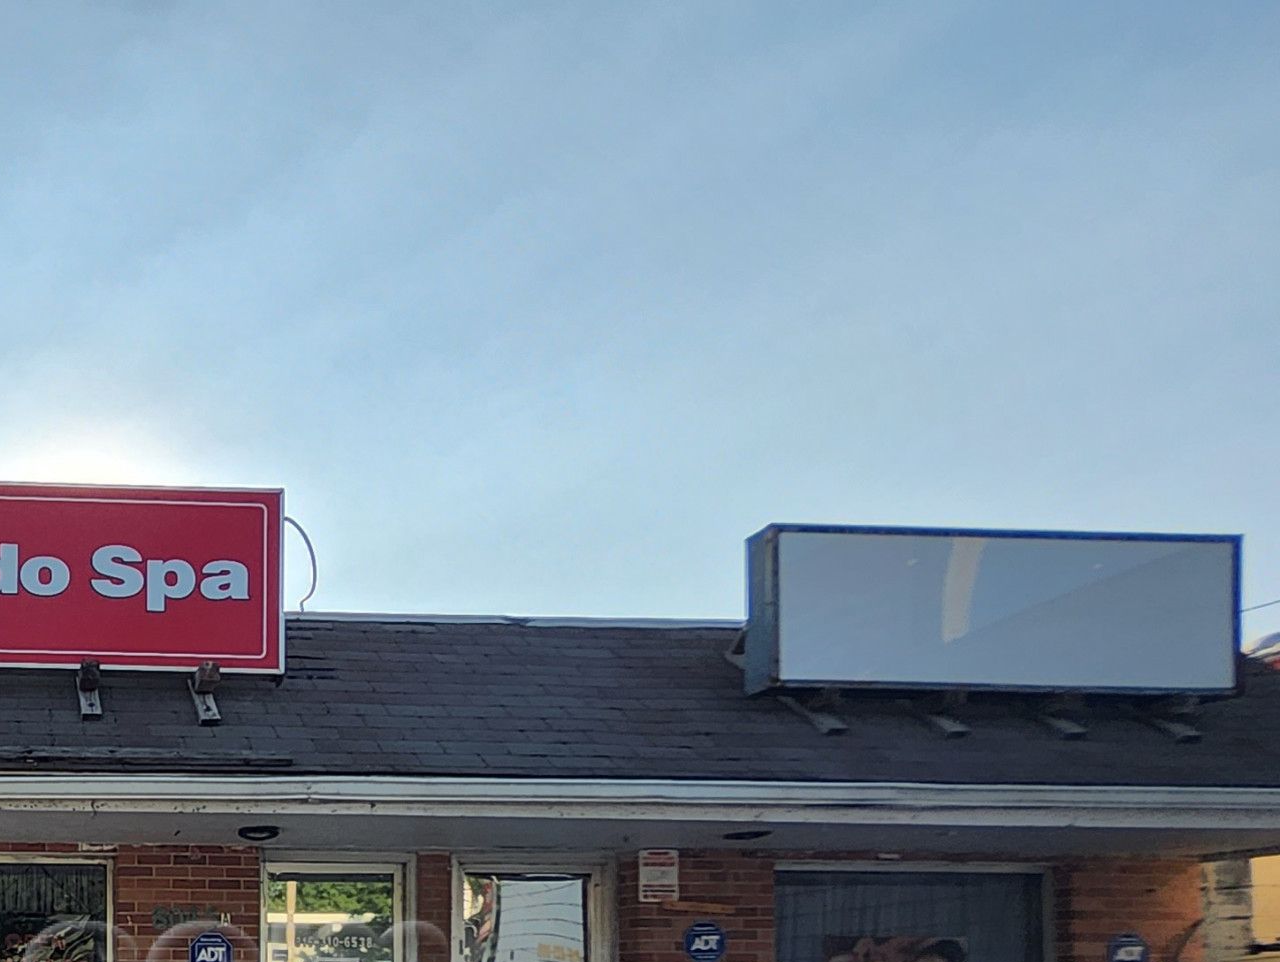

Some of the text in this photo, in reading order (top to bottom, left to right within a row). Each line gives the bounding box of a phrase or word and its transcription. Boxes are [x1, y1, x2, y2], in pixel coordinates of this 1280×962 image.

[90, 544, 250, 612] Spa
[690, 935, 721, 951] ADT
[196, 946, 227, 962] ADT
